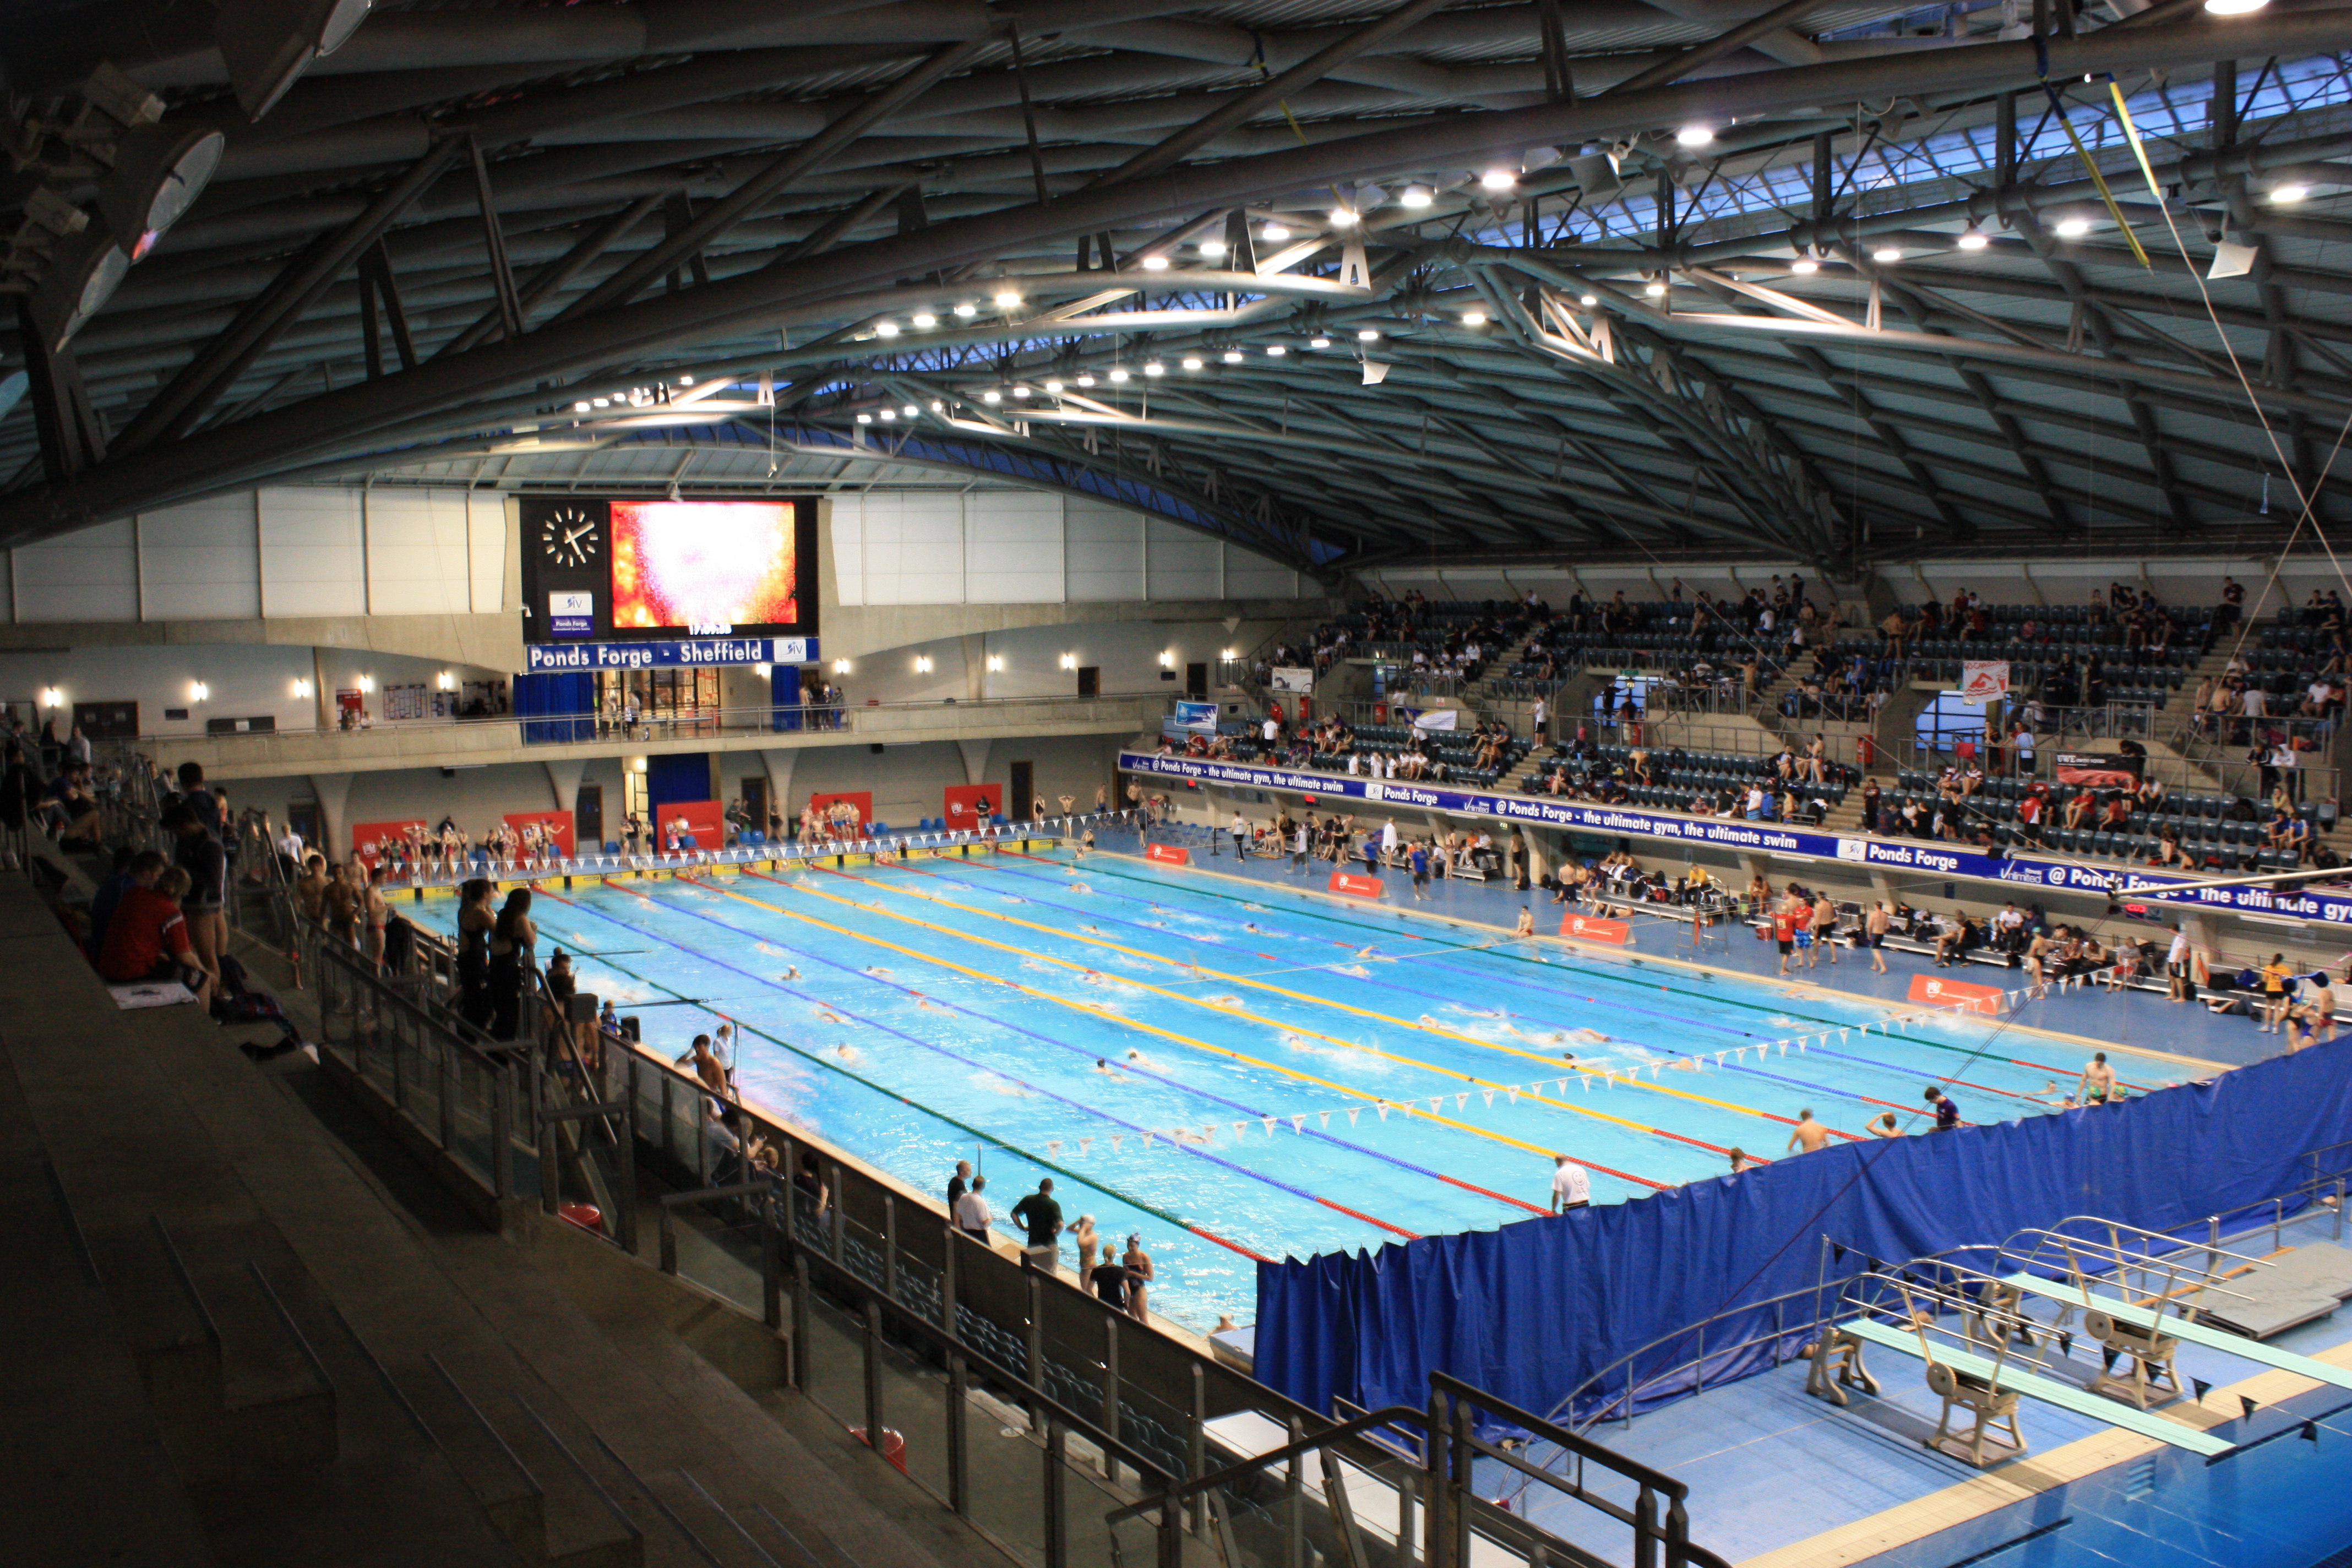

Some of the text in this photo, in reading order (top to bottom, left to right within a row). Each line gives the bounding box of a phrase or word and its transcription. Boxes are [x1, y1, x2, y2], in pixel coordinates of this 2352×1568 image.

[531, 646, 590, 667] Ponds
[598, 647, 652, 668] Forge
[680, 642, 761, 662] Sheffield
[1152, 760, 1159, 771] @
[1161, 761, 1180, 772] Ponds
[1182, 764, 1201, 776] Forge
[1208, 767, 1219, 777] the
[1222, 768, 1251, 781] ultimate
[1254, 774, 1272, 785] gym,
[1274, 774, 1286, 785] the
[1288, 776, 1320, 790] ultimate
[1322, 781, 1343, 792] swim
[1385, 787, 1438, 806] Ponds Forge
[1496, 801, 1506, 814] @
[1509, 802, 1539, 817] Ponds
[1543, 806, 1572, 823] Forge
[1584, 811, 1601, 824] the
[1604, 814, 1651, 830] ultimate
[1653, 821, 1681, 836] gym,
[1685, 823, 1704, 837] the
[1708, 826, 1760, 844] ultimate
[1763, 834, 1797, 848] swim
[1870, 845, 1958, 871] Ponds Forge
[2049, 867, 2066, 885] @
[2200, 888, 2231, 903] the
[2324, 903, 2352, 922] gy
